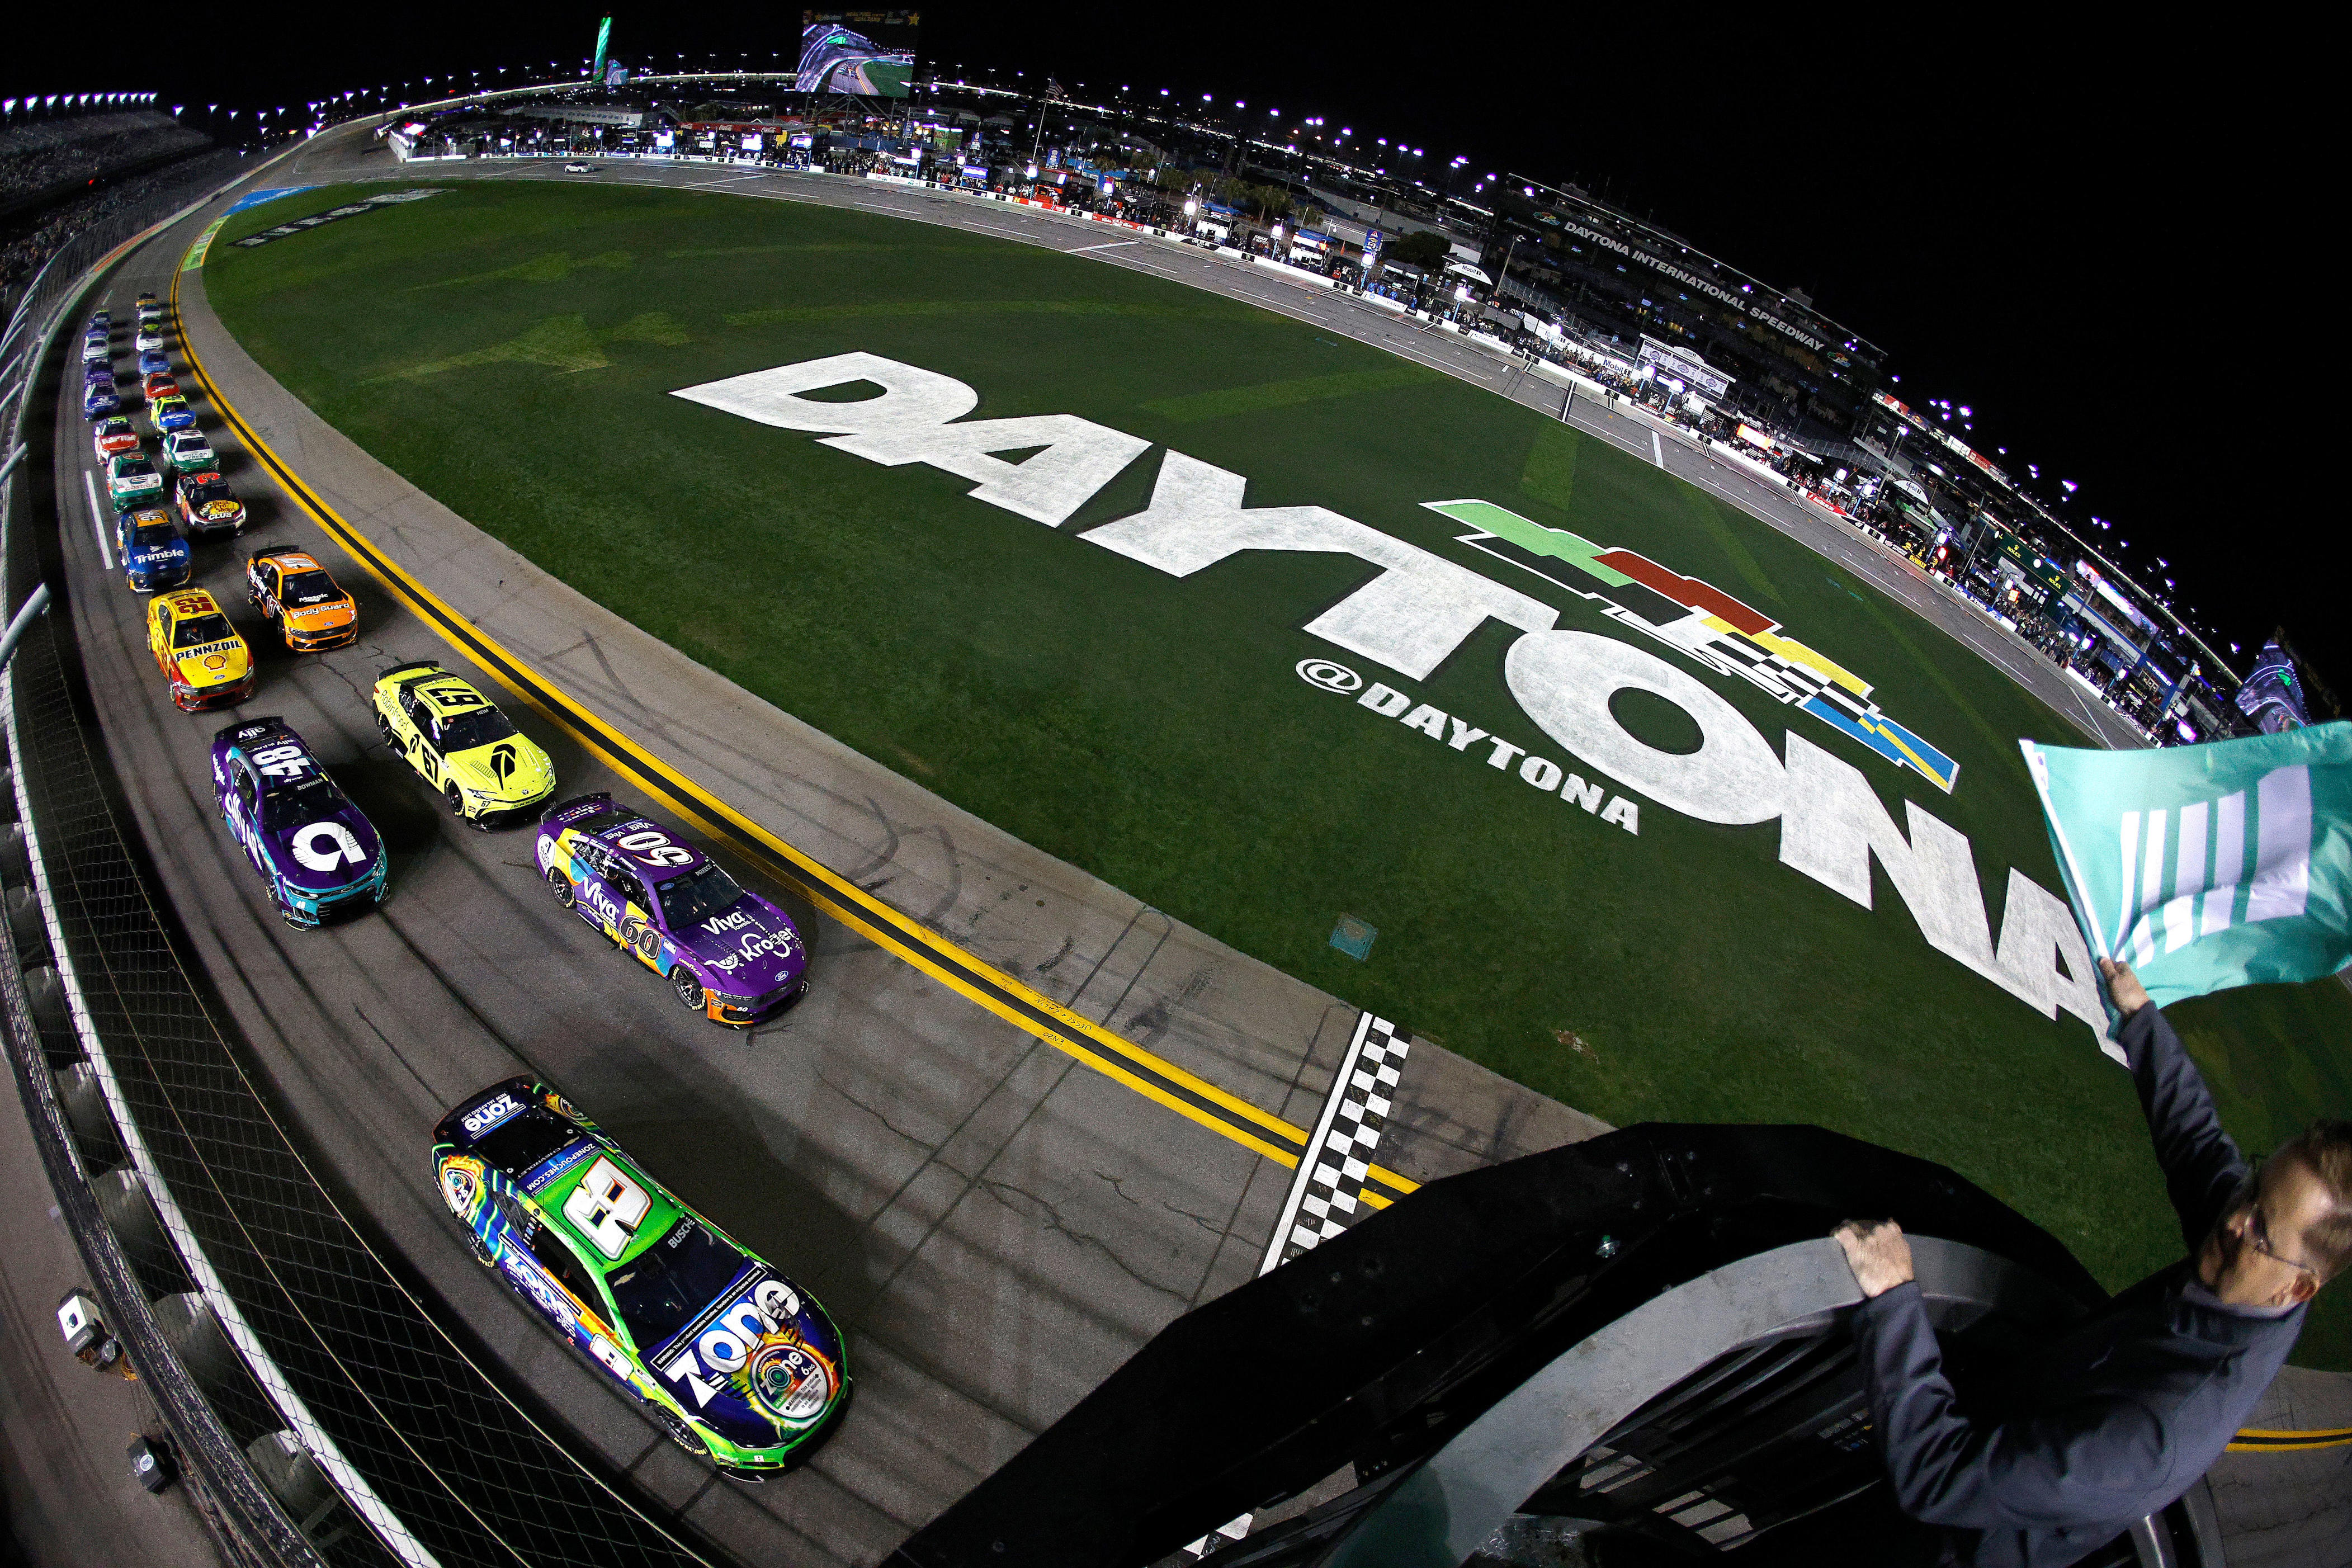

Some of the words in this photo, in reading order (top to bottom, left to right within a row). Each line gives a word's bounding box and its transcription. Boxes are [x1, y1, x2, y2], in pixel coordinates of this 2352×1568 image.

[1564, 222, 1629, 256] DAYTONA
[1632, 251, 1745, 311] INTERNATIONAL
[1750, 307, 1824, 351] SPEEDWAY
[1479, 335, 1509, 350] AdventHealth
[1604, 358, 1623, 373] Mobil
[1635, 402, 1659, 415] MENARDS
[1976, 458, 1988, 467] TOYOTA
[1906, 482, 1917, 492] Mobil
[207, 512, 232, 521] CLUB
[134, 549, 184, 564] Trimble
[2007, 546, 2022, 558] ROLEX
[2048, 577, 2061, 589] ROLEX
[174, 597, 214, 614] 22
[299, 593, 328, 602] Mosaic
[1973, 598, 1987, 610] Trimble
[292, 608, 319, 619] Body
[320, 603, 351, 612] Guard
[176, 640, 242, 663] PENNZOIL
[426, 688, 485, 707] 67
[380, 690, 409, 730] Robinhood
[669, 352, 2130, 1064] DAYTONA
[238, 726, 266, 739] ally
[1295, 658, 1639, 836] @DAYTONA
[252, 745, 311, 776] 48
[422, 743, 438, 784] 67
[297, 778, 323, 791] BOWMAN
[514, 797, 541, 808] CAMRY
[604, 831, 625, 840] Viva
[627, 822, 655, 832] Viva
[618, 831, 693, 867] 60
[695, 864, 713, 876] PREECE
[583, 876, 620, 919] Viva
[599, 908, 617, 927] Towels
[701, 911, 745, 934] Viva
[731, 919, 752, 931] Towels
[619, 915, 662, 960] 60
[738, 927, 795, 962] Kroger
[678, 958, 702, 977] GOODYEAR
[776, 971, 788, 981] Ford
[1043, 1032, 1064, 1046] ENZO
[464, 1095, 519, 1131] zone
[526, 1144, 596, 1191] ZONEPOUCHES.COM
[563, 1155, 652, 1260] 8
[668, 1219, 696, 1249] BUSCH
[504, 1245, 575, 1325] zone
[556, 1316, 576, 1338] FICO
[657, 1348, 676, 1365] WARNING:
[674, 1341, 682, 1350] This
[693, 1319, 706, 1333] contains
[705, 1309, 719, 1323] nicotine.
[716, 1298, 729, 1312] Nicotine
[665, 1281, 800, 1409] zone
[589, 1333, 635, 1382] 8
[760, 1352, 803, 1396] zone
